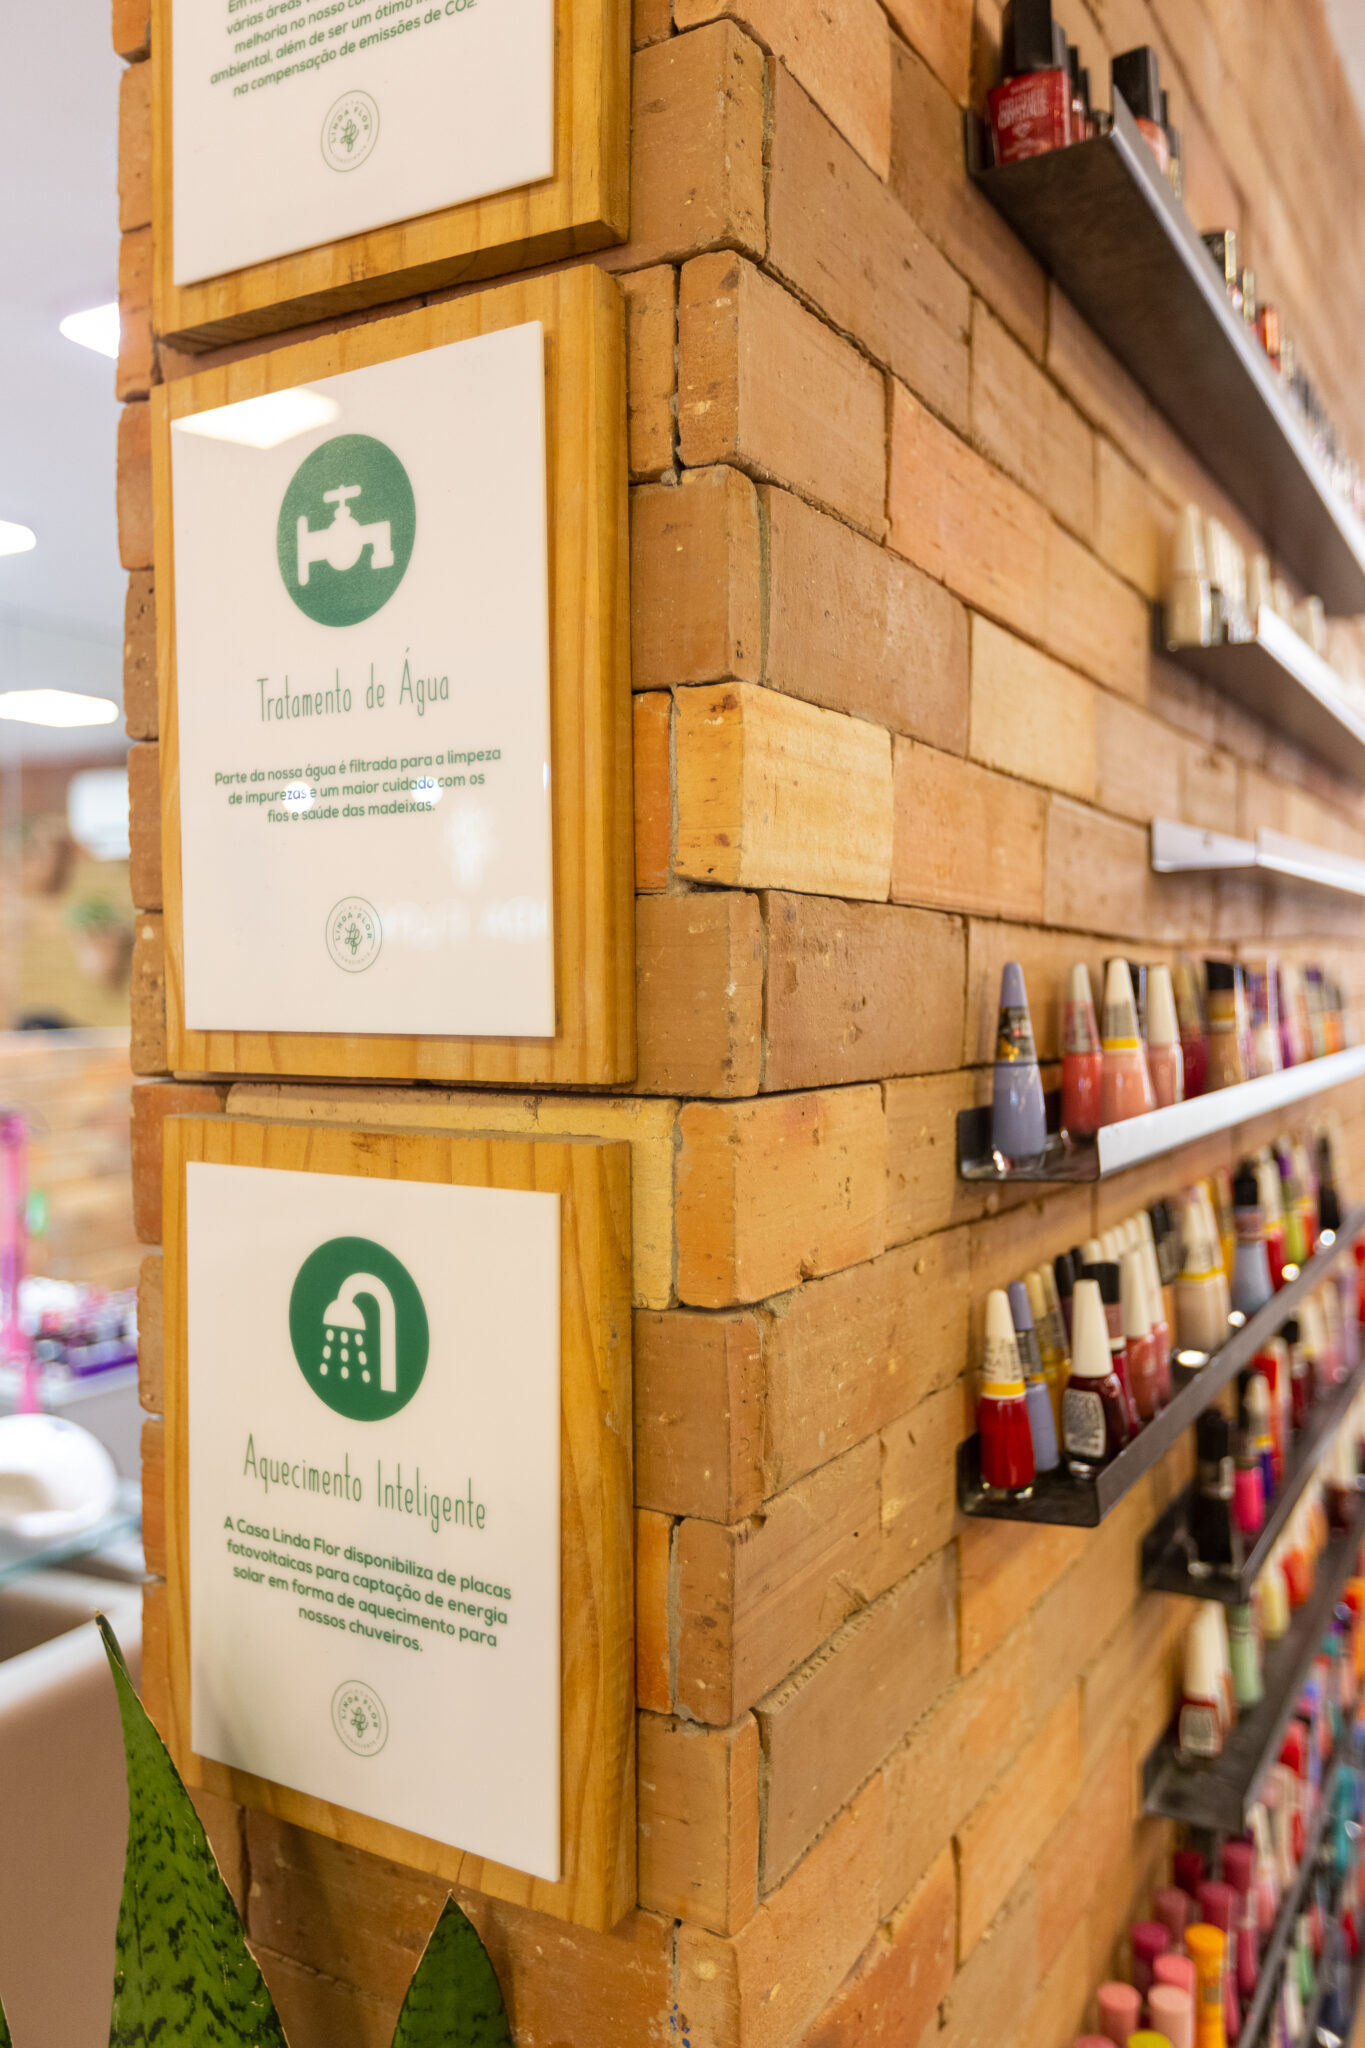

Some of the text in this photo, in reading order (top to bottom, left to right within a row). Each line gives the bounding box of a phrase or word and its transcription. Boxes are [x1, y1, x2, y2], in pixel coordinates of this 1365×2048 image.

[210, 49, 273, 84] ambiental,
[275, 40, 306, 59] além
[308, 30, 325, 46] de
[328, 22, 349, 39] ser
[351, 13, 372, 29] um
[375, 0, 413, 20] ótimo
[226, 0, 302, 35] várias áreas
[233, 83, 249, 97] na
[250, 49, 337, 85] compensação
[339, 41, 356, 57] de
[359, 19, 421, 49] emissões
[423, 9, 441, 24] de
[234, 1, 345, 54] melhoria no nosso
[256, 647, 449, 722] Tratamento de Água
[215, 749, 501, 785] Parte da nossa água é filtrada para a limpeza
[228, 773, 485, 806] de impurezas e um maior cuidado com os
[267, 800, 436, 823] fios e saúde das madeixas.
[243, 1433, 486, 1533] Aquecimento Inteligente
[224, 1516, 512, 1600] A Casa Linda Flor disponibiliza de placas
[227, 1538, 508, 1627] fotovoltaicas para captação de energia
[233, 1566, 497, 1647] solar em forma de aquecimento para
[299, 1607, 423, 1652] nossos chuveiros.
